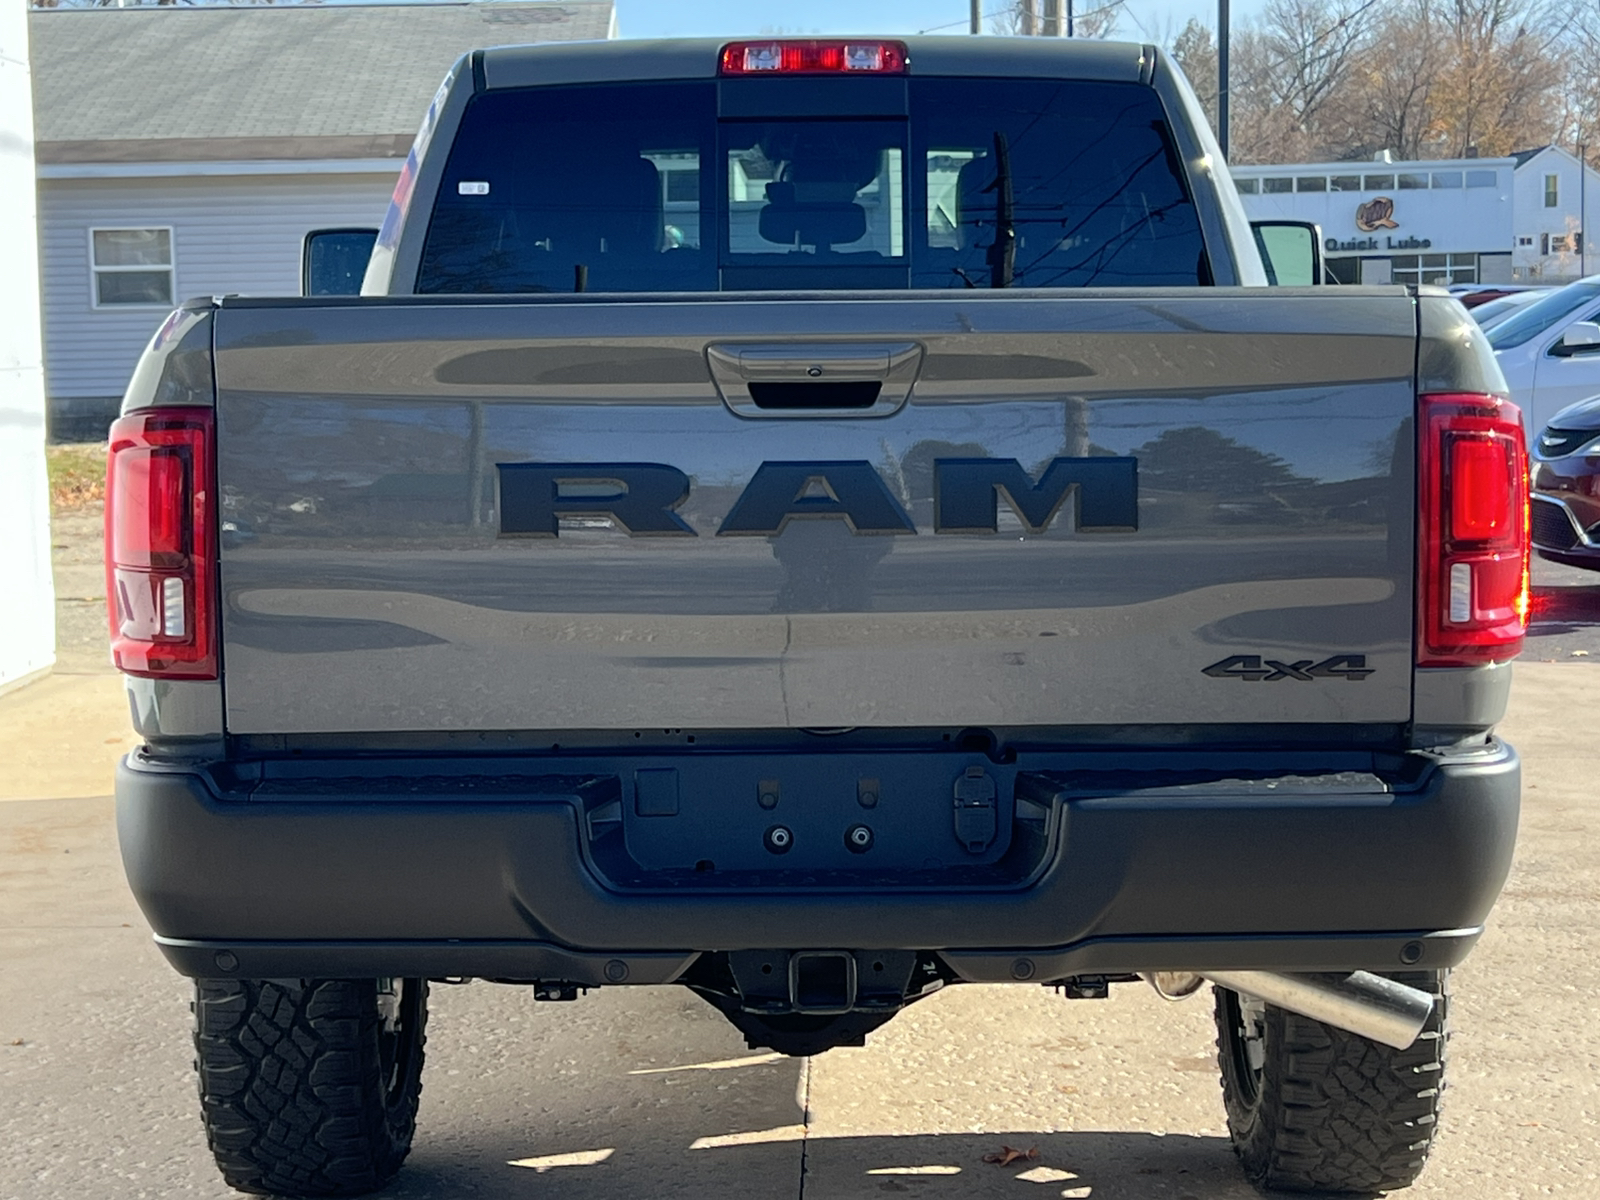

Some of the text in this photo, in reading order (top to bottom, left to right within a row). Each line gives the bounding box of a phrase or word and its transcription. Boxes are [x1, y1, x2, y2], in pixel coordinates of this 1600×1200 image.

[1324, 235, 1432, 251] Quick Lube
[496, 456, 1138, 538] RAM
[1200, 655, 1377, 681] 4x4
